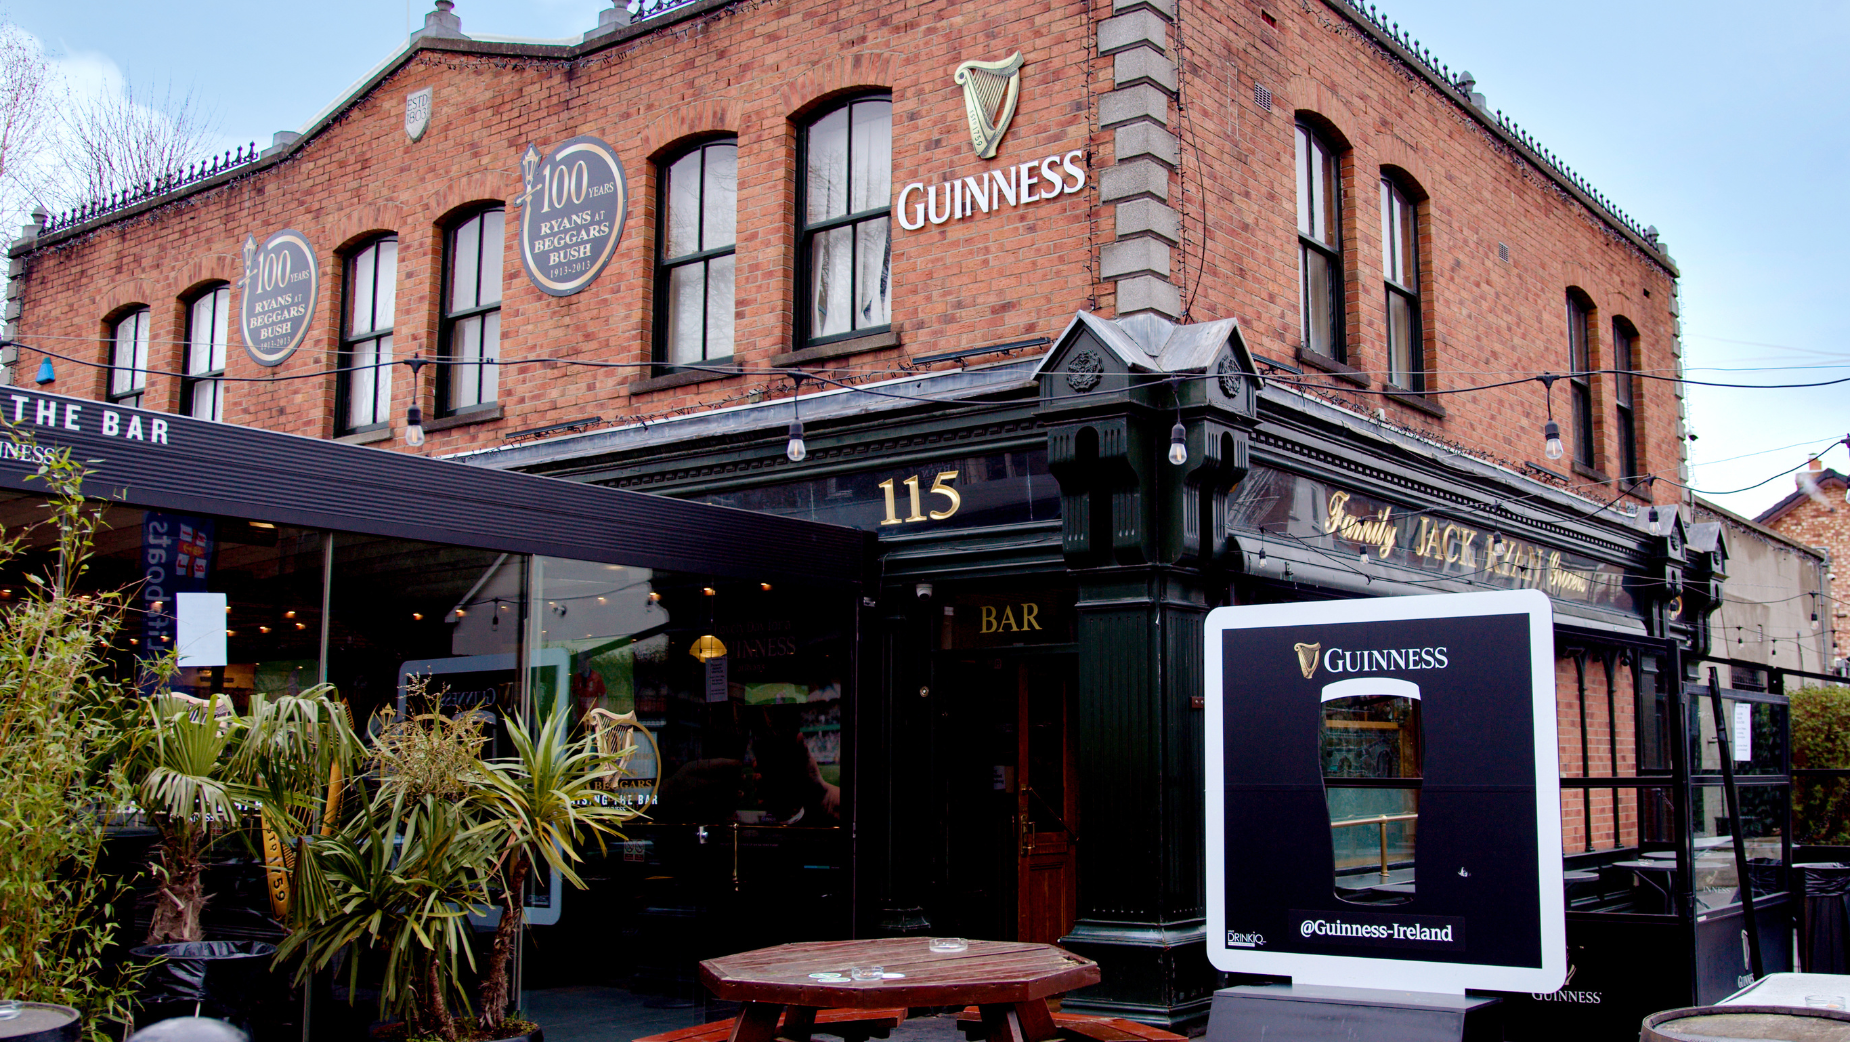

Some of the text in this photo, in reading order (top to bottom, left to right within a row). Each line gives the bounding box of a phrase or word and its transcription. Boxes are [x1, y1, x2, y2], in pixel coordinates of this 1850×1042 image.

[971, 126, 983, 147] 1759
[541, 160, 615, 213] 100 YEARS
[897, 150, 1086, 231] GUINNESS
[540, 210, 606, 236] RYANS AT
[533, 221, 610, 254] BEGGARS
[548, 243, 592, 266] BUSH
[256, 250, 310, 294] 100 YEARS
[550, 260, 591, 279] 1913-2013
[249, 304, 306, 329] BEGGARS
[254, 293, 303, 314] RYANS AT
[260, 322, 292, 340] BUSH
[10, 394, 169, 445] THE BAR
[878, 470, 961, 525] 115
[1324, 490, 1398, 559] Family
[1415, 516, 1478, 568] JACK
[1485, 534, 1544, 583] RYAN
[979, 603, 1042, 633] BAR
[1323, 646, 1449, 673] GUINNESS
[638, 795, 658, 805] BAR
[1300, 919, 1454, 942] @Guinness-Ireland
